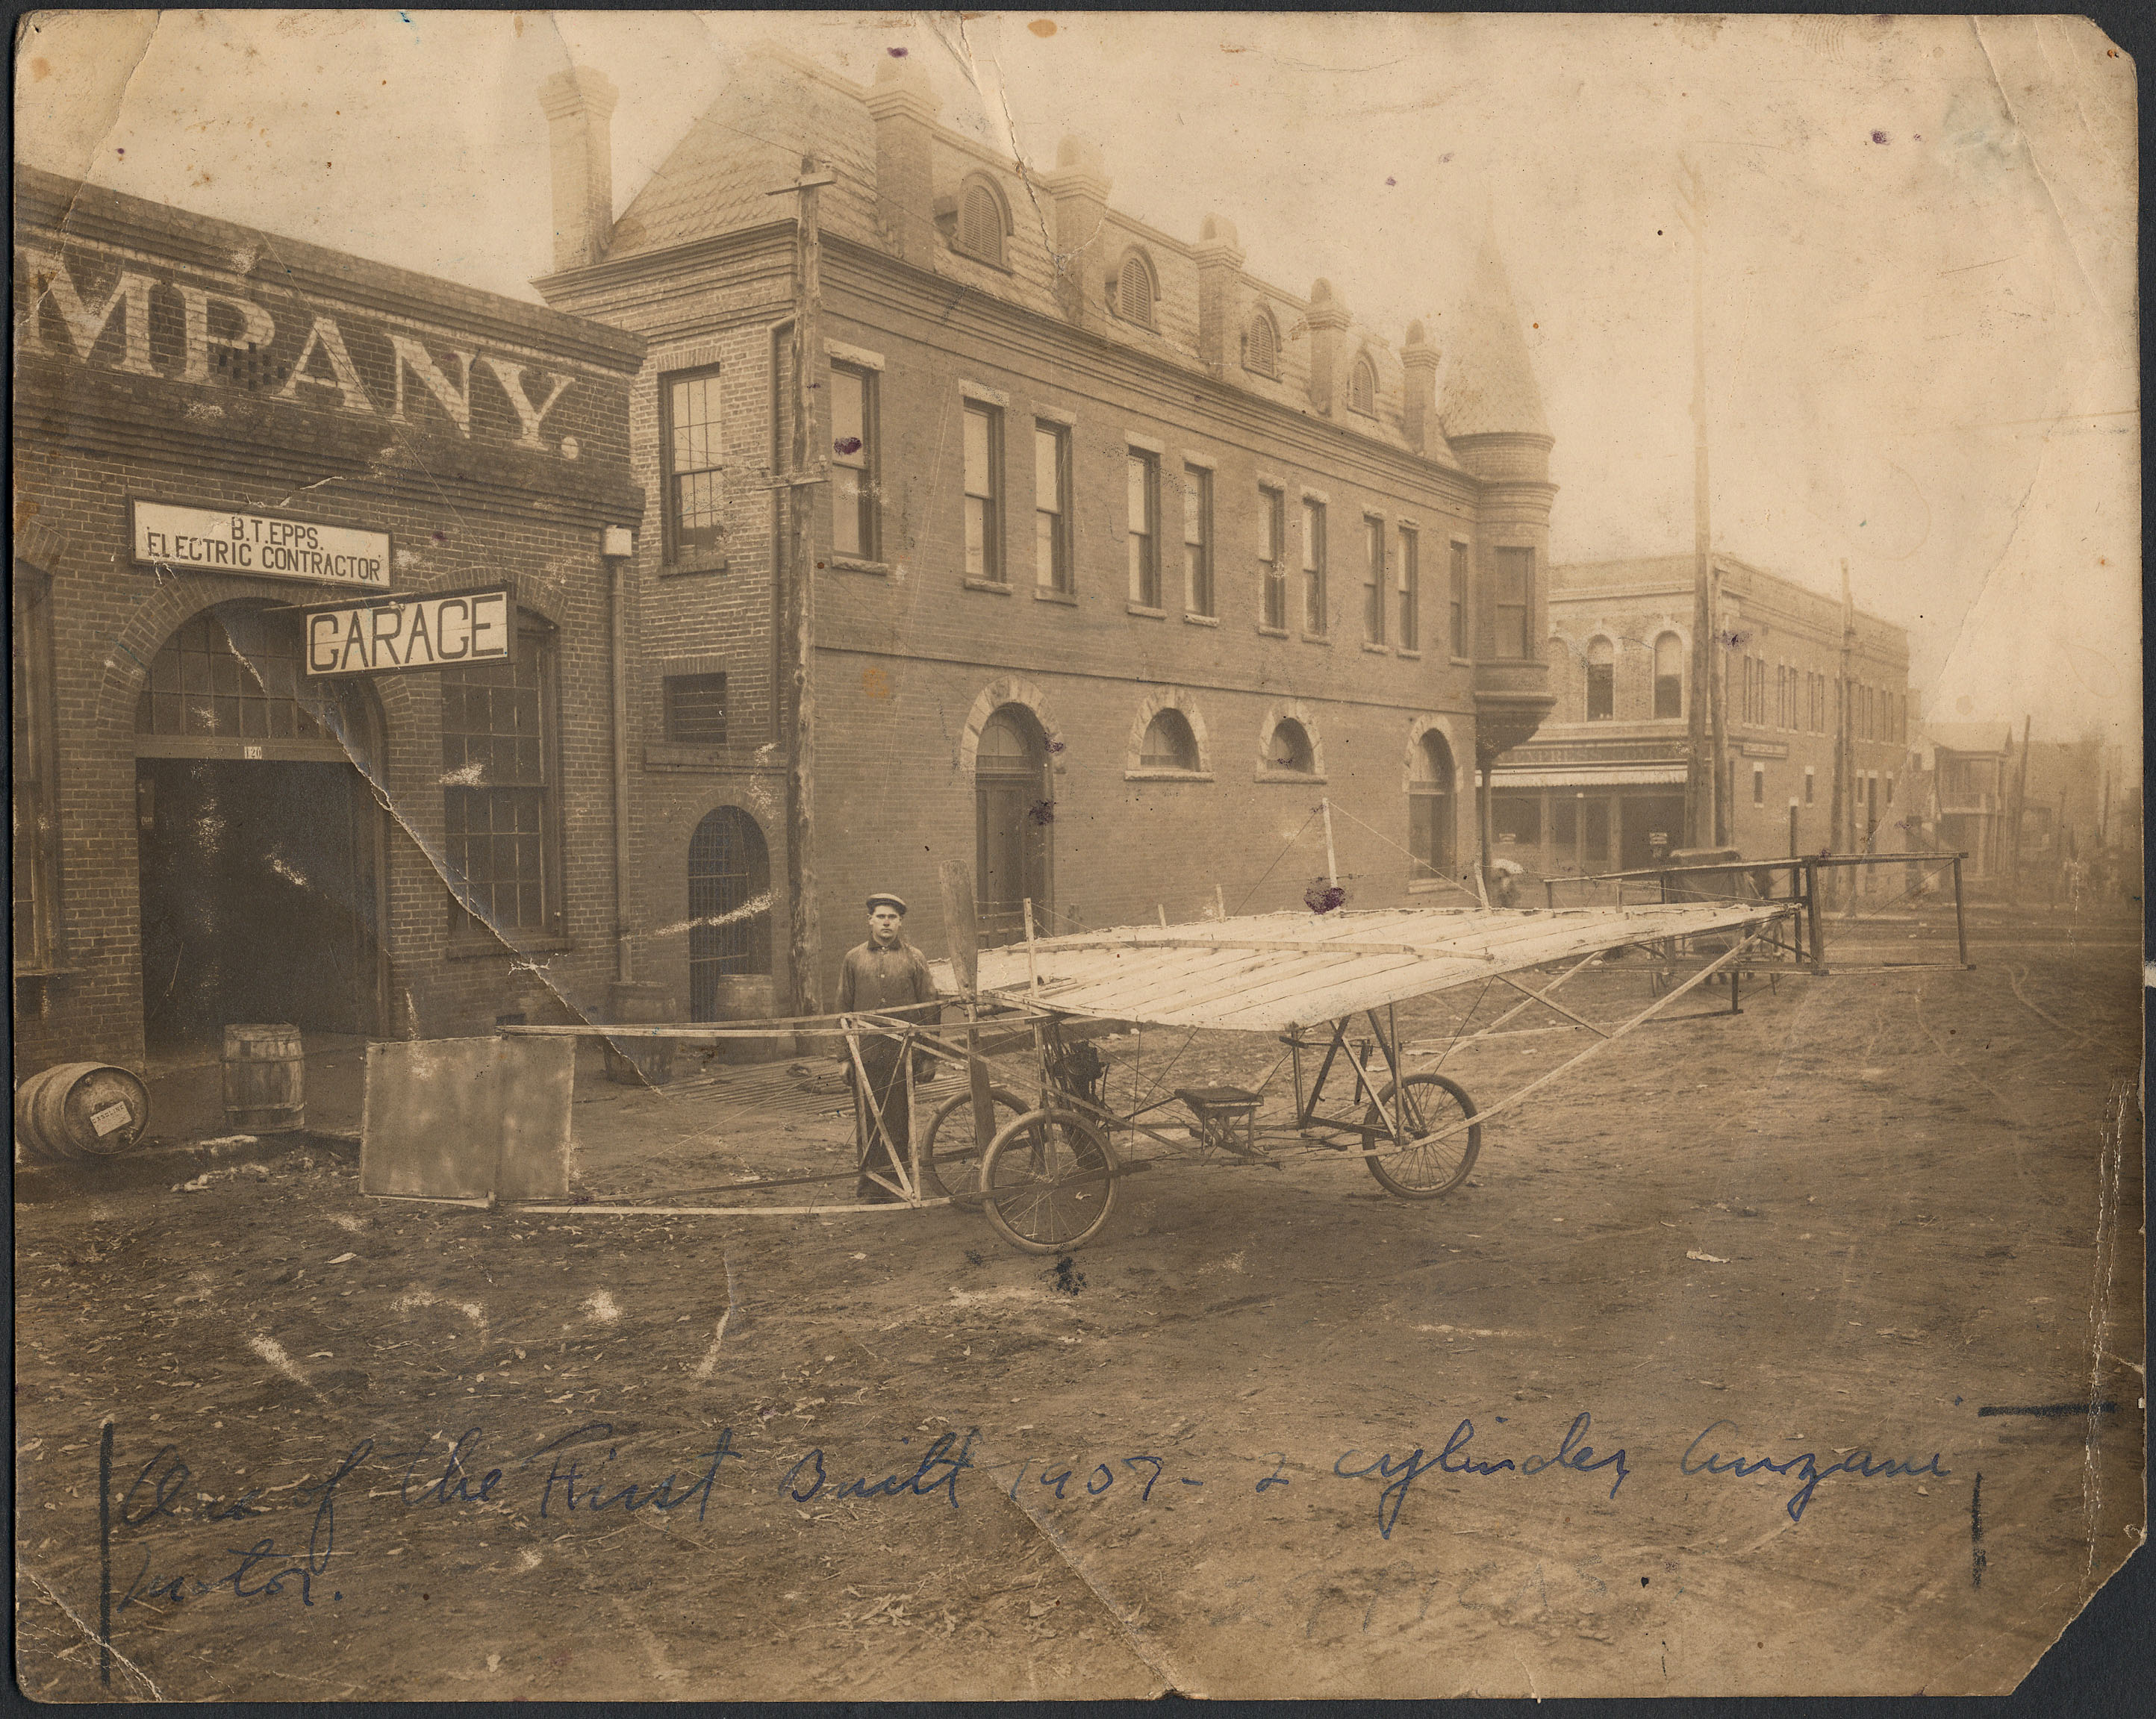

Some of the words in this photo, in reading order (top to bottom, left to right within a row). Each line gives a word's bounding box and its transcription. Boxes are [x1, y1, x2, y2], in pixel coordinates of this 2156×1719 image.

[14, 249, 579, 461] MPANY.
[148, 531, 252, 567] ELECTRIC
[261, 546, 381, 581] CONTRACTOR
[310, 593, 505, 672] GARAGE
[246, 747, 261, 758] 120
[92, 1105, 125, 1124] GASOLINE
[293, 1438, 374, 1576] of
[380, 1426, 503, 1506] the
[520, 1423, 743, 1521] First
[776, 1426, 985, 1509] Built
[1255, 1450, 1290, 1492] 2
[1334, 1411, 1630, 1541] cylinder
